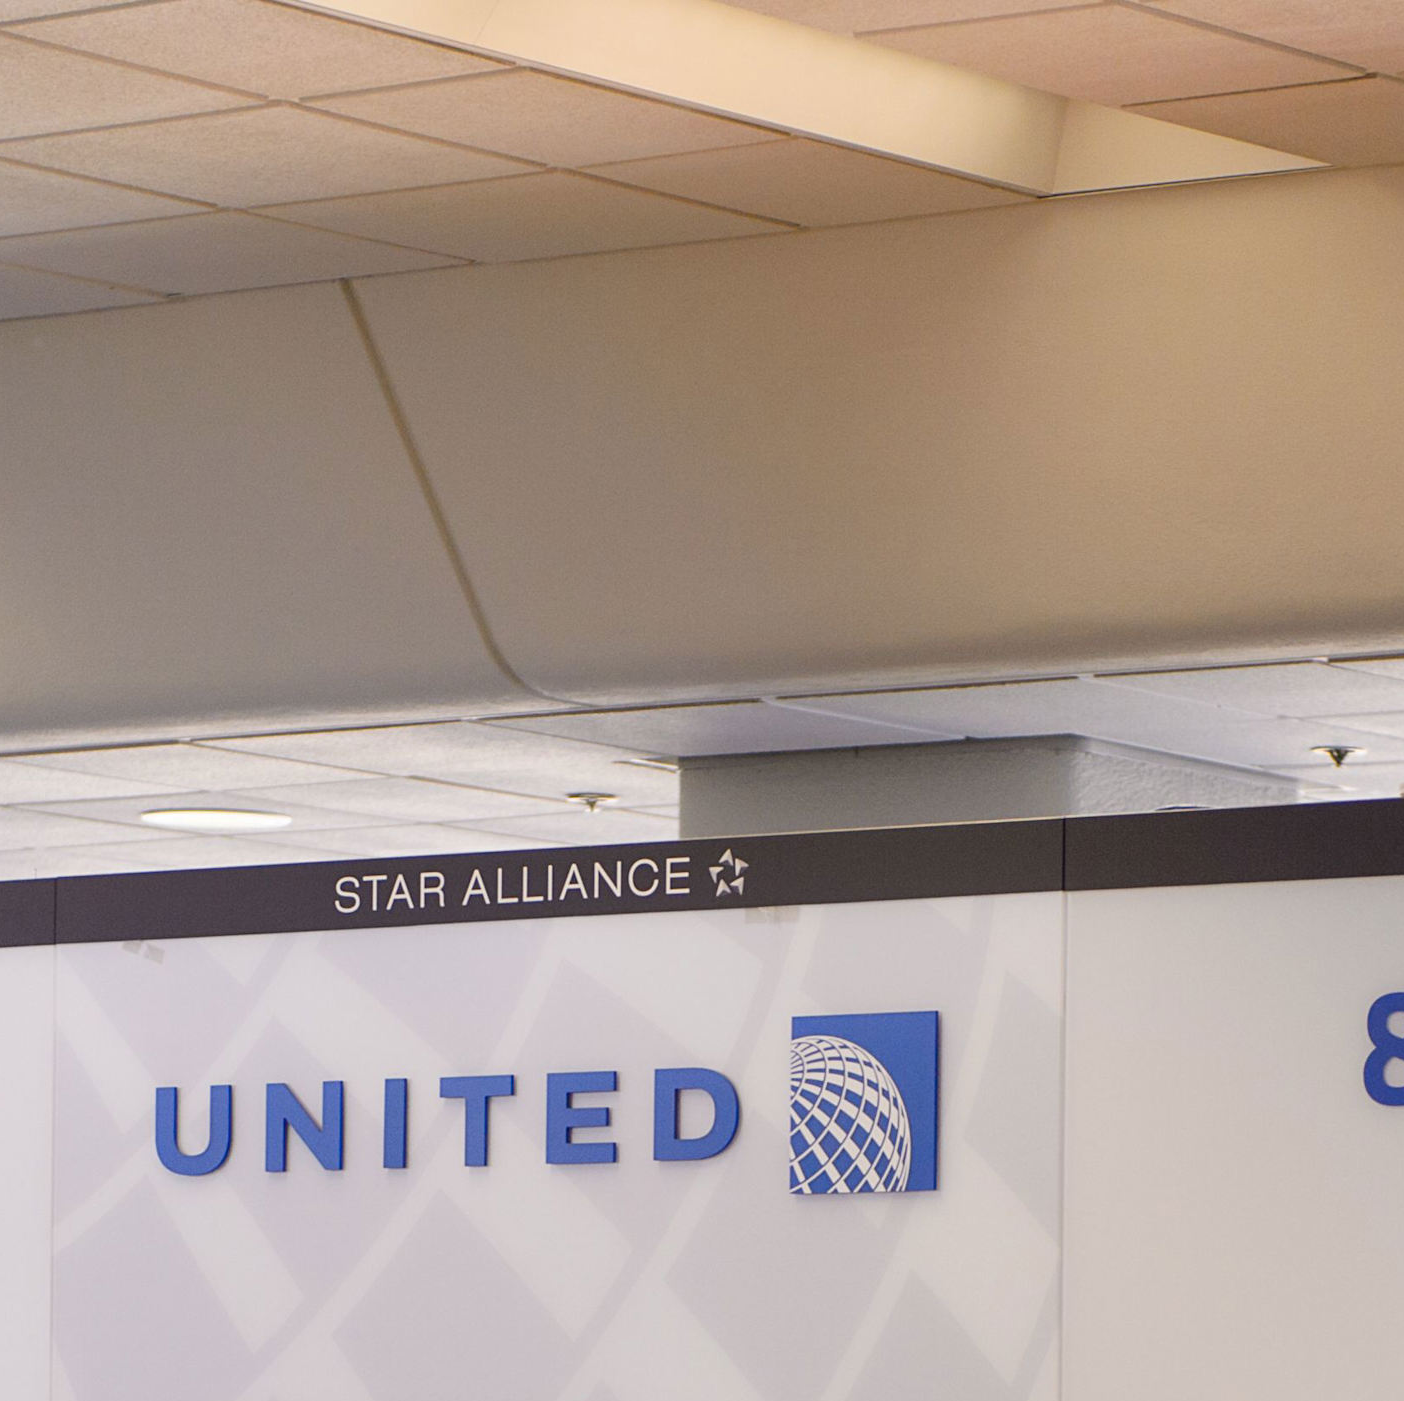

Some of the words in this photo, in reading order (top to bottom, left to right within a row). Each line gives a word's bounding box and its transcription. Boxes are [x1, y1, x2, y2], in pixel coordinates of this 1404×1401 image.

[334, 872, 446, 914] STAR
[462, 857, 691, 906] ALLIANCE
[155, 1068, 740, 1177] UNITED
